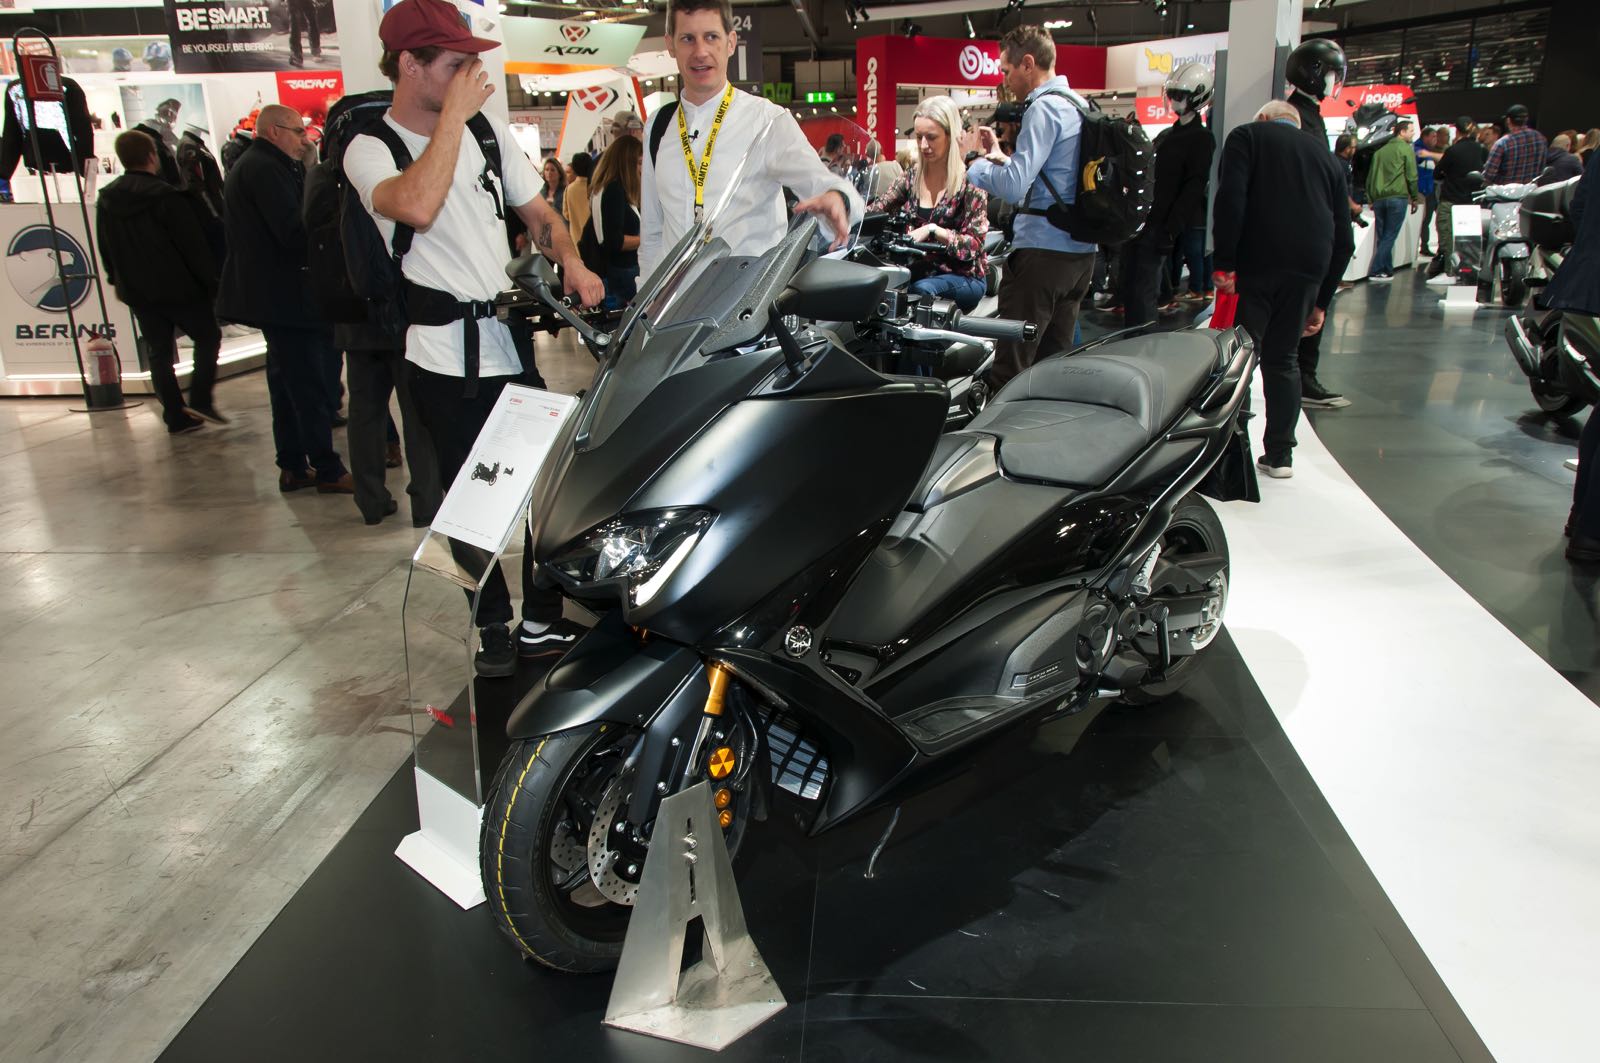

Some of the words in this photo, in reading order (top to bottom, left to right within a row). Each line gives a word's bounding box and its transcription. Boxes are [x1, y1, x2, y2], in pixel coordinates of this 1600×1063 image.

[176, 8, 209, 31] BE
[208, 6, 269, 24] SMART
[733, 15, 753, 31] 24
[182, 44, 193, 53] BE
[232, 43, 244, 51] BE
[863, 56, 878, 139] rembo
[1365, 92, 1403, 104] ROADS
[16, 323, 117, 339] BERNG
